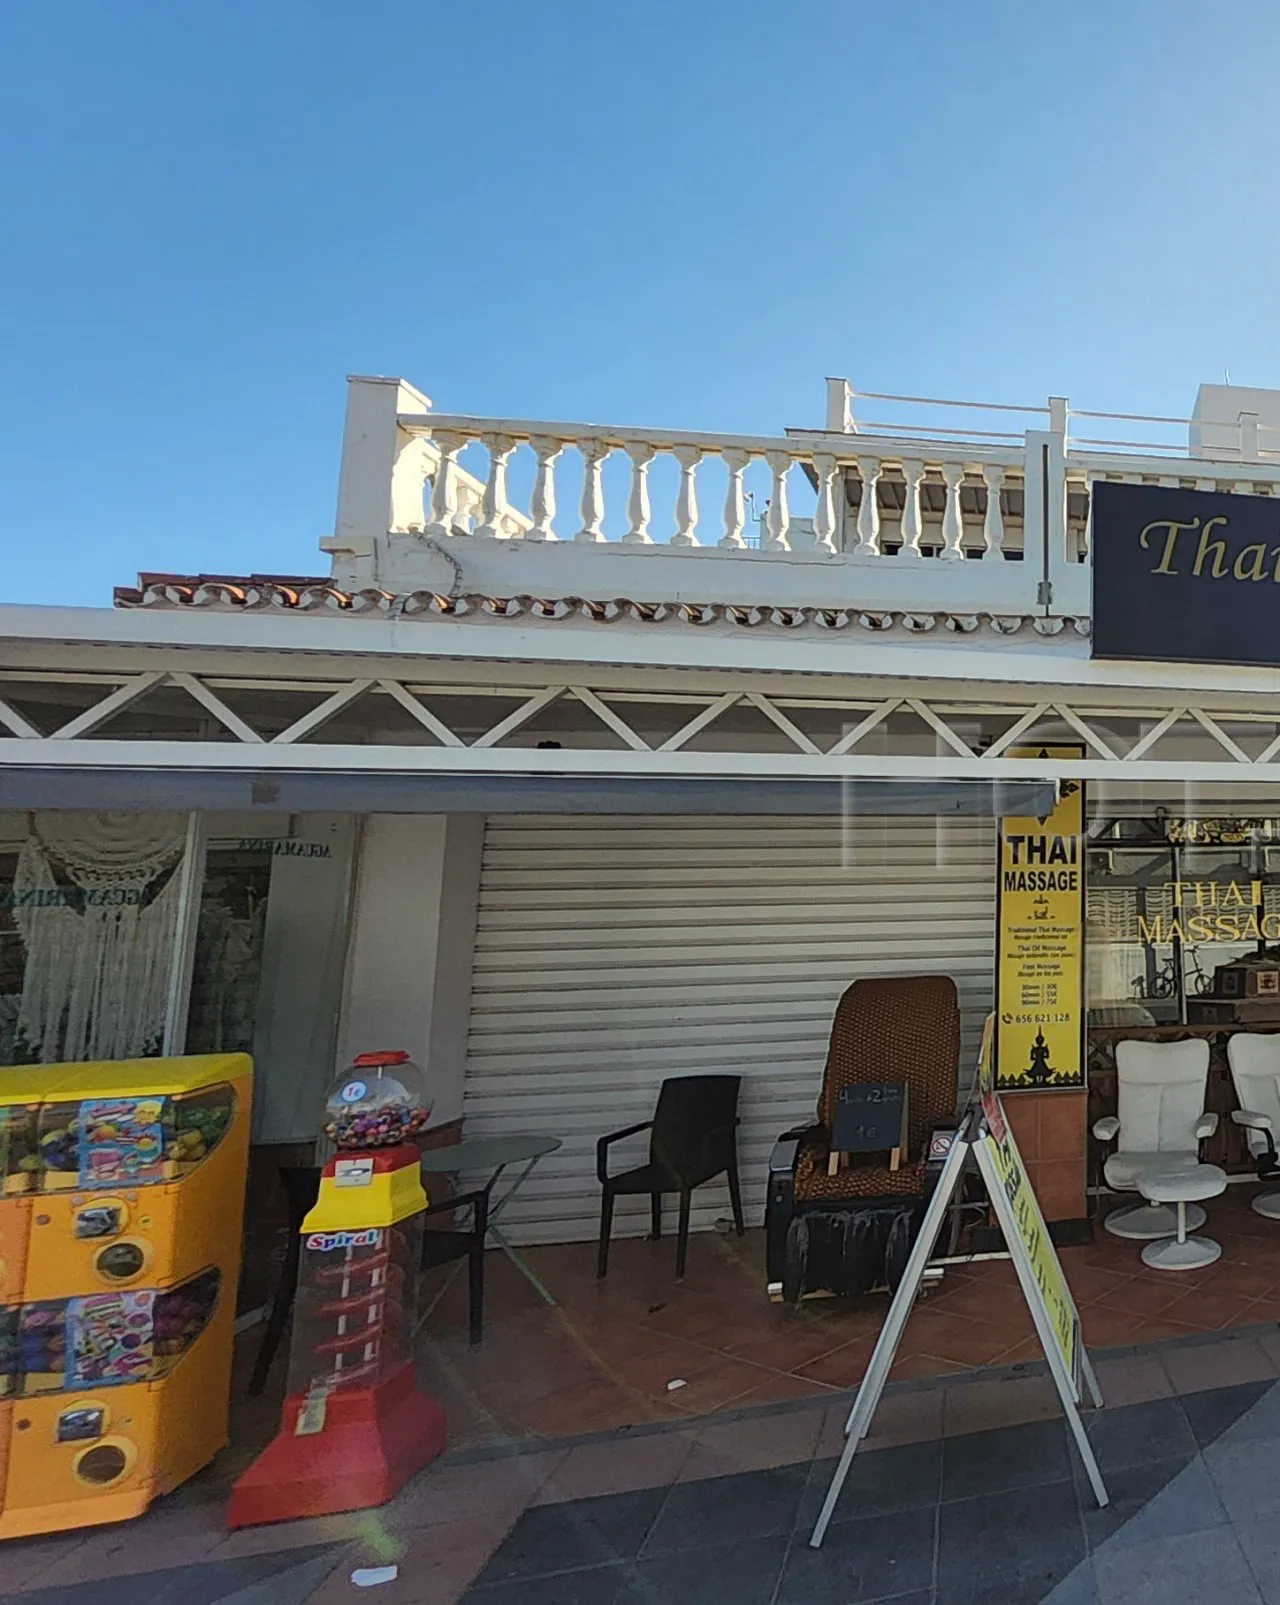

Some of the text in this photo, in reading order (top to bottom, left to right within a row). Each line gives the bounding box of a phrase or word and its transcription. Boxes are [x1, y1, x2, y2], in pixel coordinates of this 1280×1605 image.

[1006, 835, 1077, 865] THAI
[1004, 871, 1078, 892] MASSAGE
[1164, 880, 1263, 907] THAI
[1016, 1013, 1070, 1023] 656 621 128
[309, 1231, 377, 1250] Spiral
